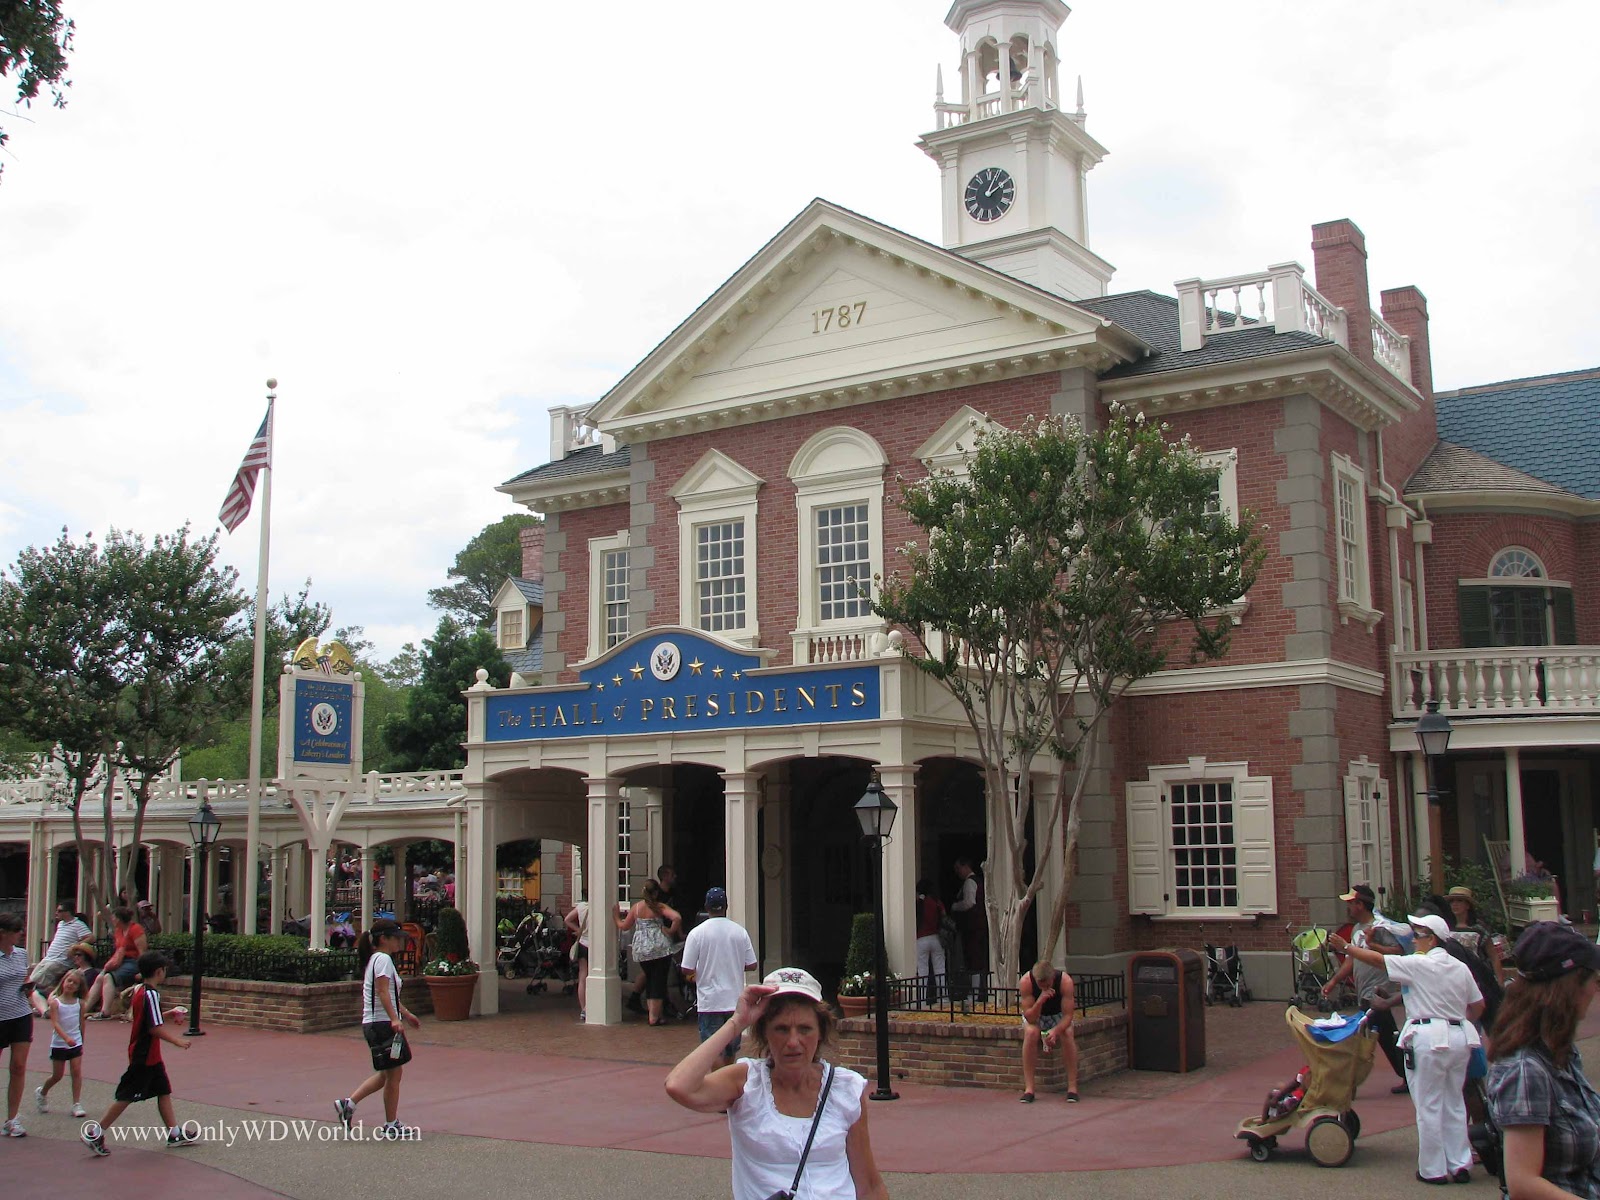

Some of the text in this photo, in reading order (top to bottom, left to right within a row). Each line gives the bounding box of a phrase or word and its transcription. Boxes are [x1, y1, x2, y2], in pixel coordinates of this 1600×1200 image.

[811, 301, 867, 333] 1787
[498, 682, 865, 727] The HALL of PRESIDENTS
